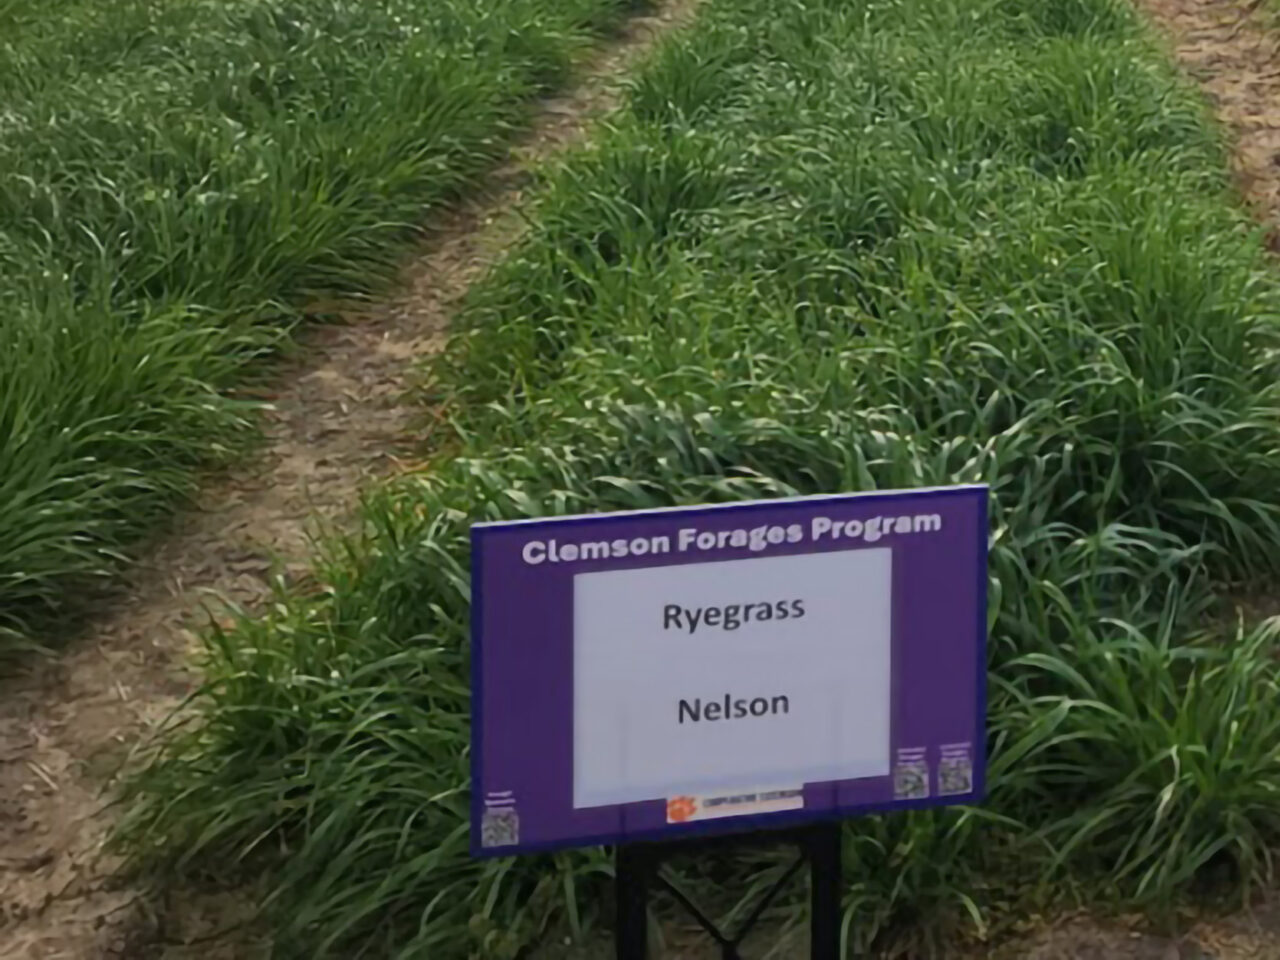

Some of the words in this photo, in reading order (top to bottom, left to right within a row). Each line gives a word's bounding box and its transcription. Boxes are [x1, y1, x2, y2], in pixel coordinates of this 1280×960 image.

[523, 535, 669, 564] Clemson
[679, 524, 802, 551] Forages
[812, 514, 940, 541] Program
[663, 599, 806, 634] Ryegrass
[678, 693, 789, 724] Nelson
